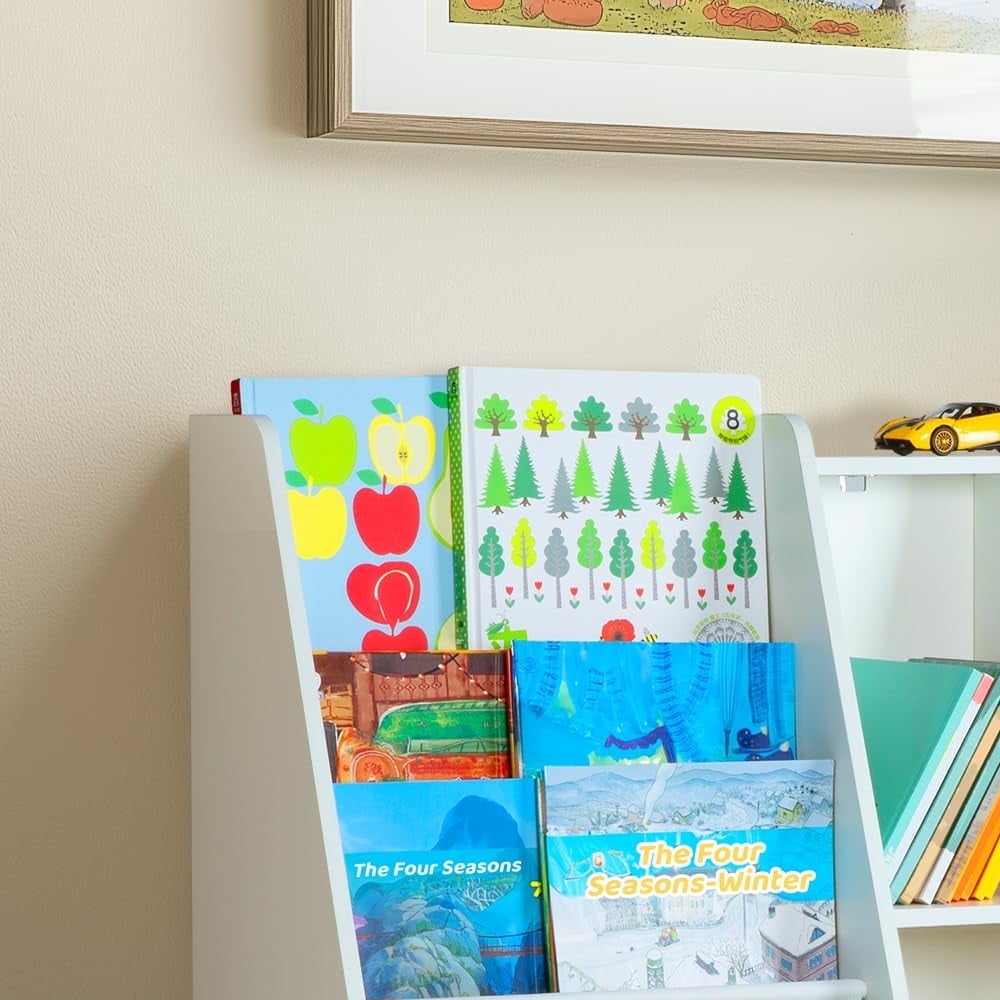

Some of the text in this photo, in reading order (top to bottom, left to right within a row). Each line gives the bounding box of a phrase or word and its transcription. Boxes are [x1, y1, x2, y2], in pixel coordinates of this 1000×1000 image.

[726, 408, 740, 430] 8
[638, 841, 764, 866] The Four
[354, 859, 522, 878] The Four Seasons
[587, 867, 815, 897] Seasons-Winter
